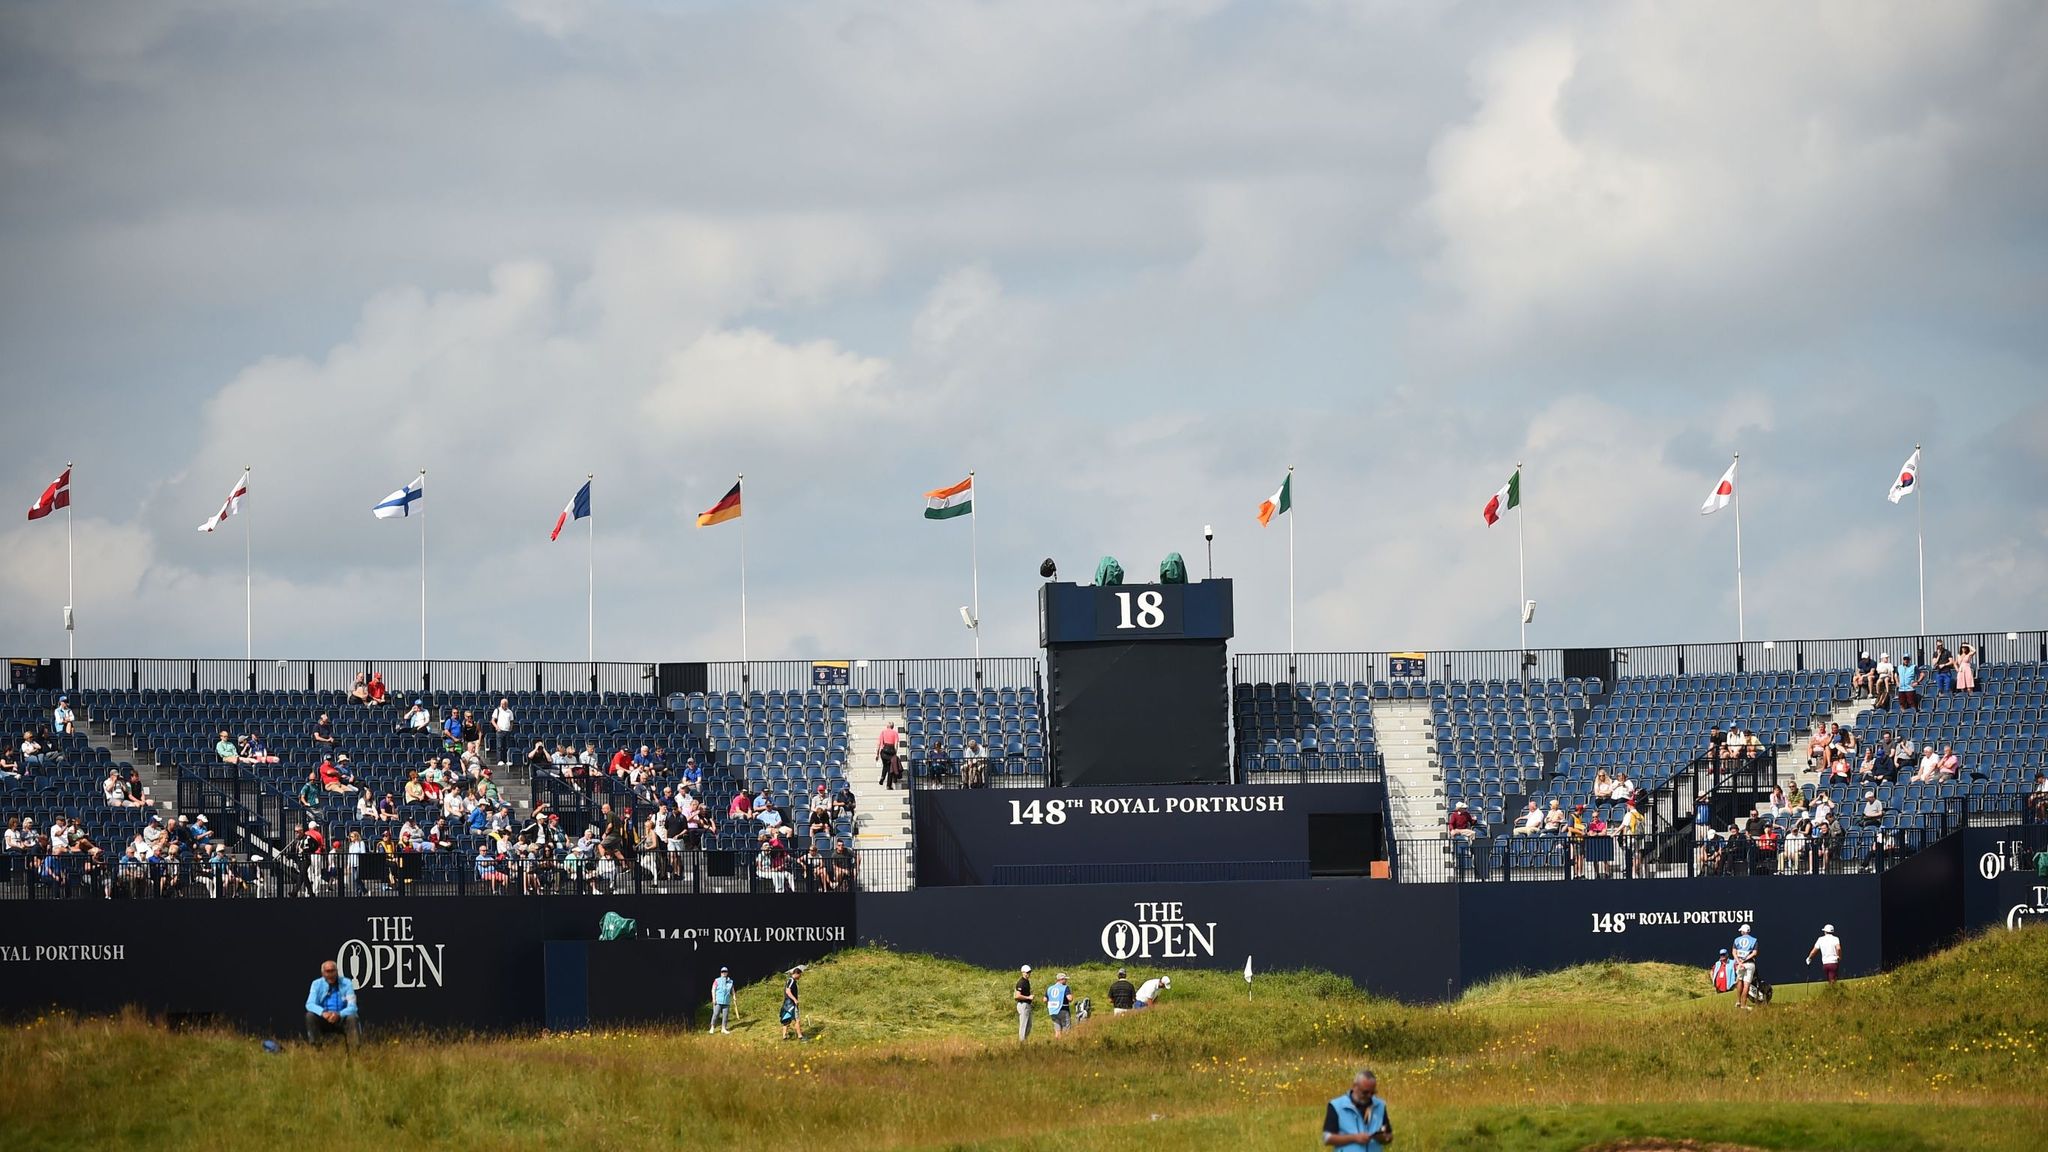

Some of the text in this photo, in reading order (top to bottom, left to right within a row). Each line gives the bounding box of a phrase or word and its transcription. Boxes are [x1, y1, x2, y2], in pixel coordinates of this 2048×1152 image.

[1114, 590, 1165, 629] 18
[1008, 795, 1285, 825] 148TH ROYAL PORTRUSH
[1134, 901, 1184, 922] THE
[1591, 909, 1754, 934] 148TH ROYAL PORTRUSH
[367, 916, 414, 942] THE
[714, 927, 762, 943] ROYAL
[765, 926, 845, 942] PORTRUSH
[1101, 919, 1217, 960] OPEN
[36, 944, 125, 961] PORTRUSH
[336, 938, 446, 990] OPEN
